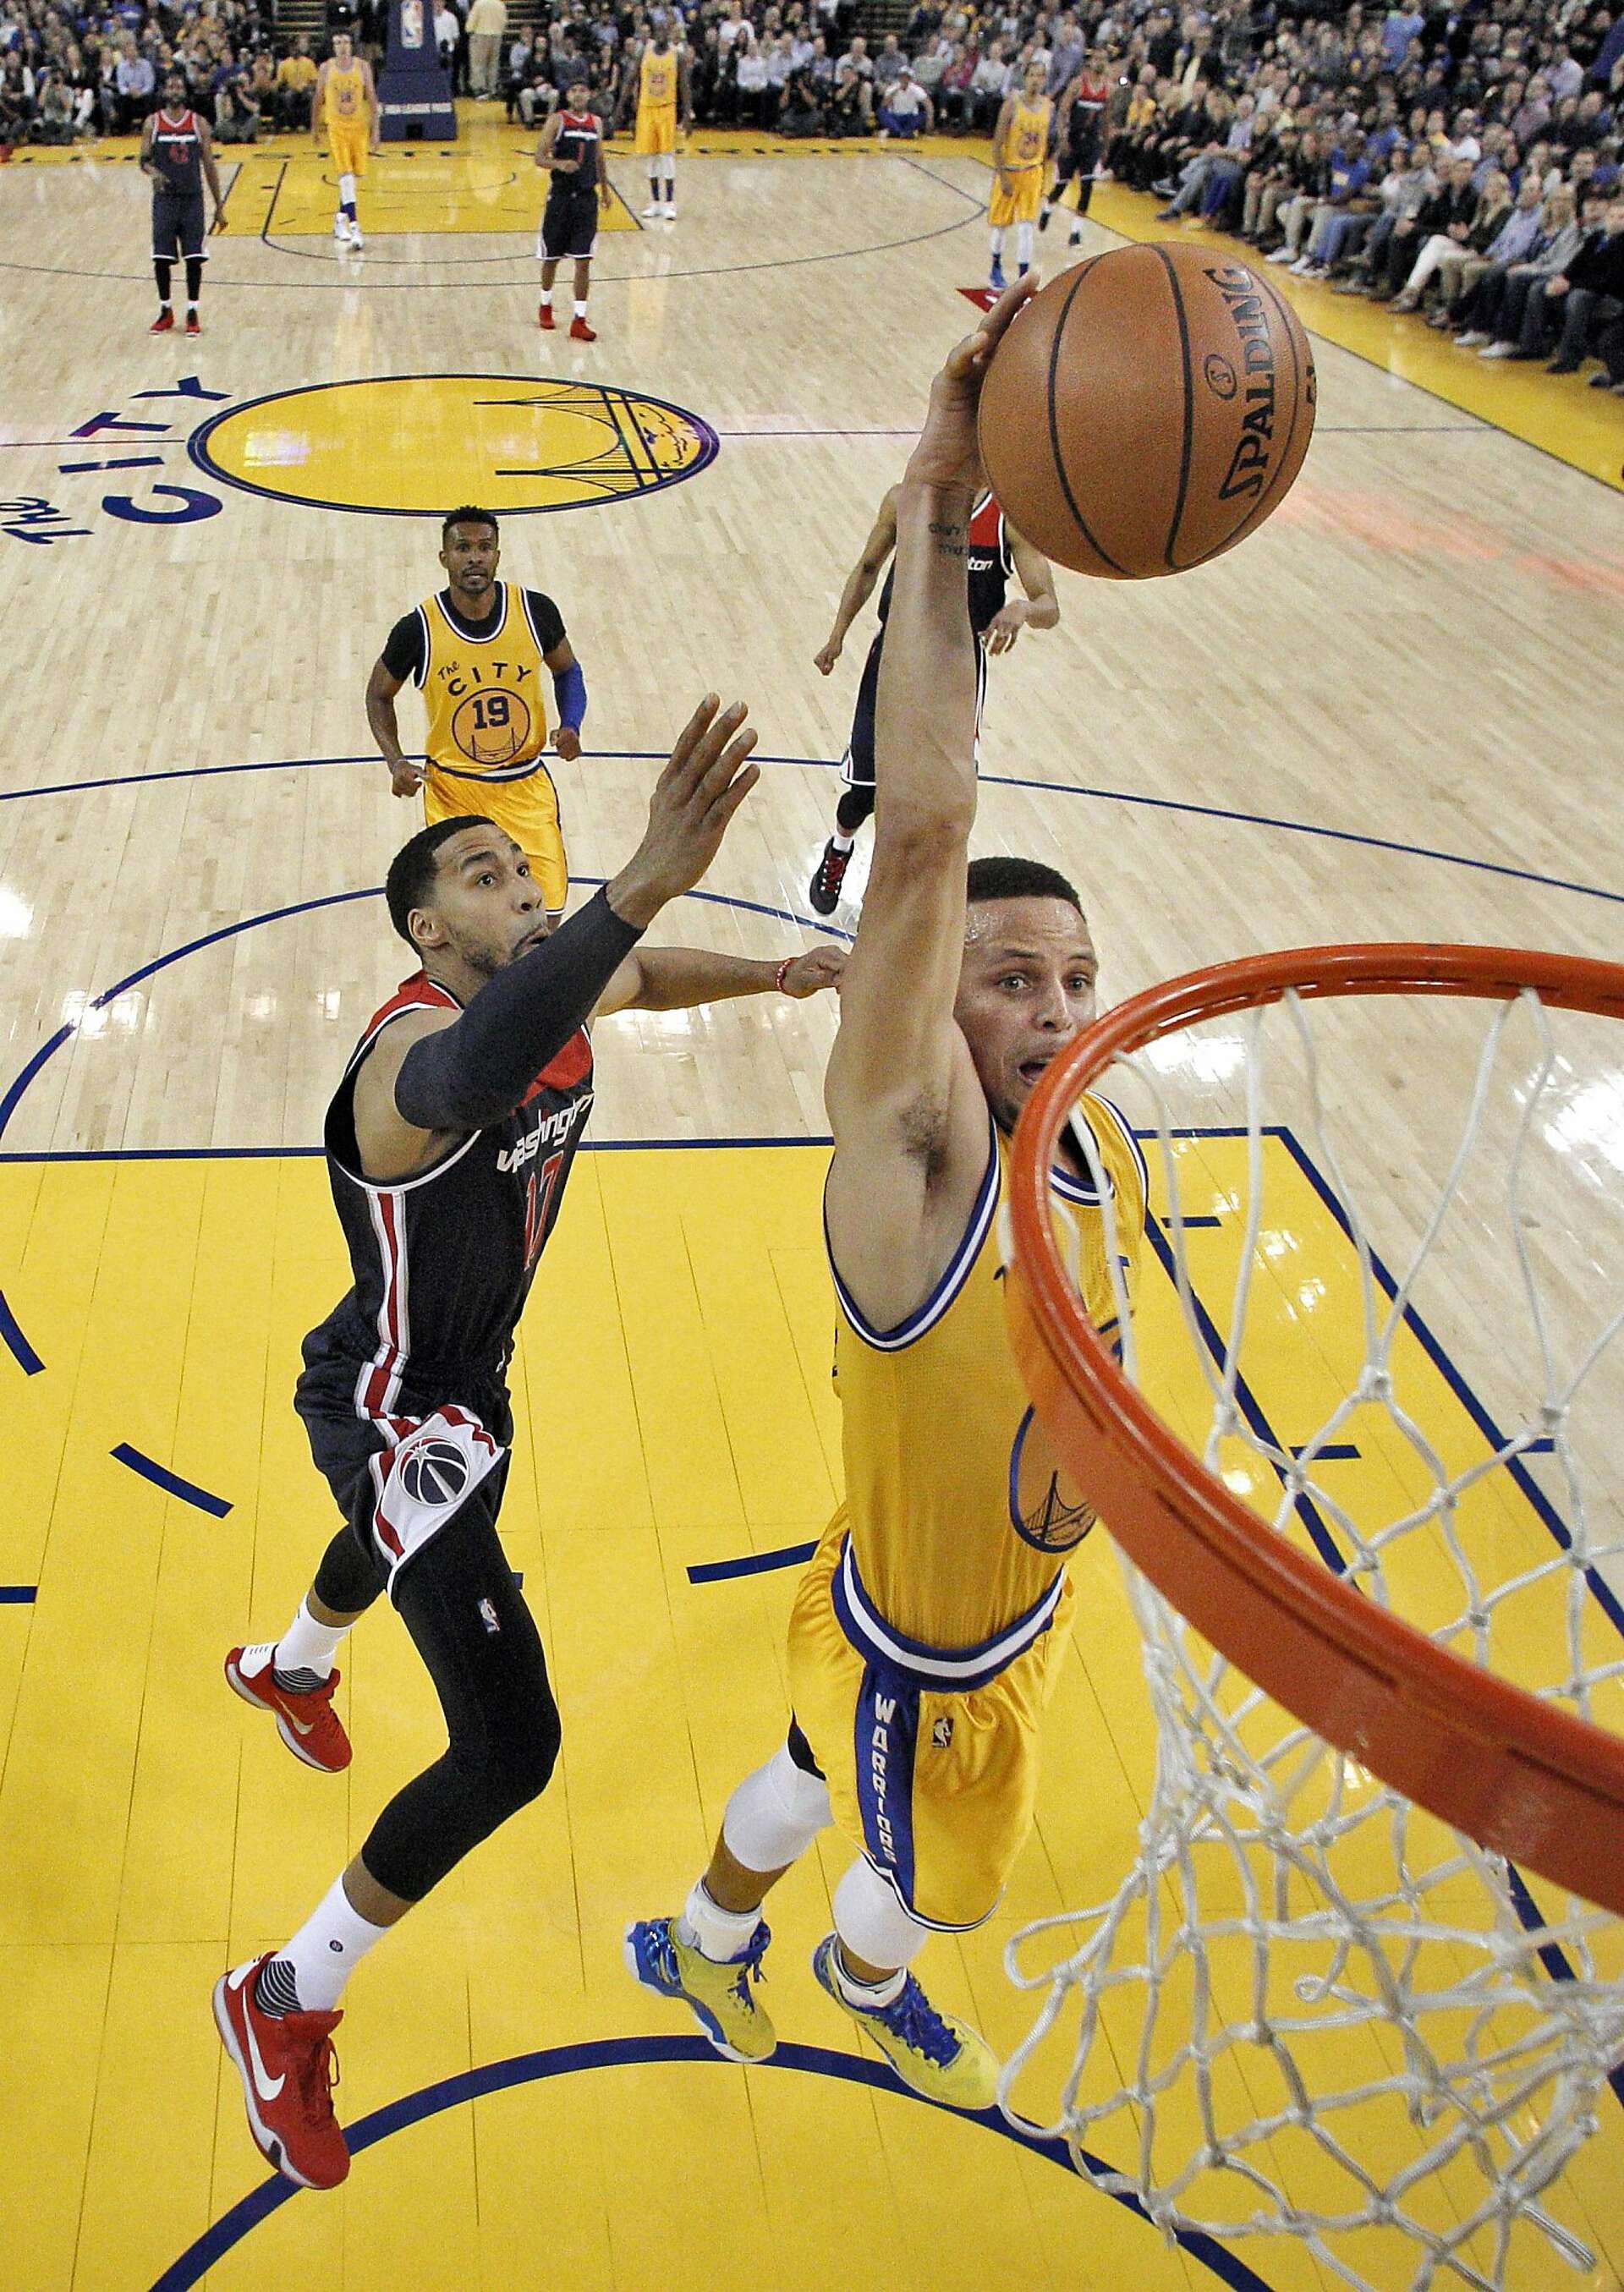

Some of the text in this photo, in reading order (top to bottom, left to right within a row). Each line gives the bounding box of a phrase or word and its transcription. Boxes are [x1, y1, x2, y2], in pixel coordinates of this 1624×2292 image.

[1203, 268, 1274, 501] SPALDING
[58, 376, 233, 524] CITY
[437, 661, 460, 680] The
[448, 663, 531, 696] CITY
[473, 696, 509, 729] 19
[872, 1693, 897, 1863] WARRIORS
